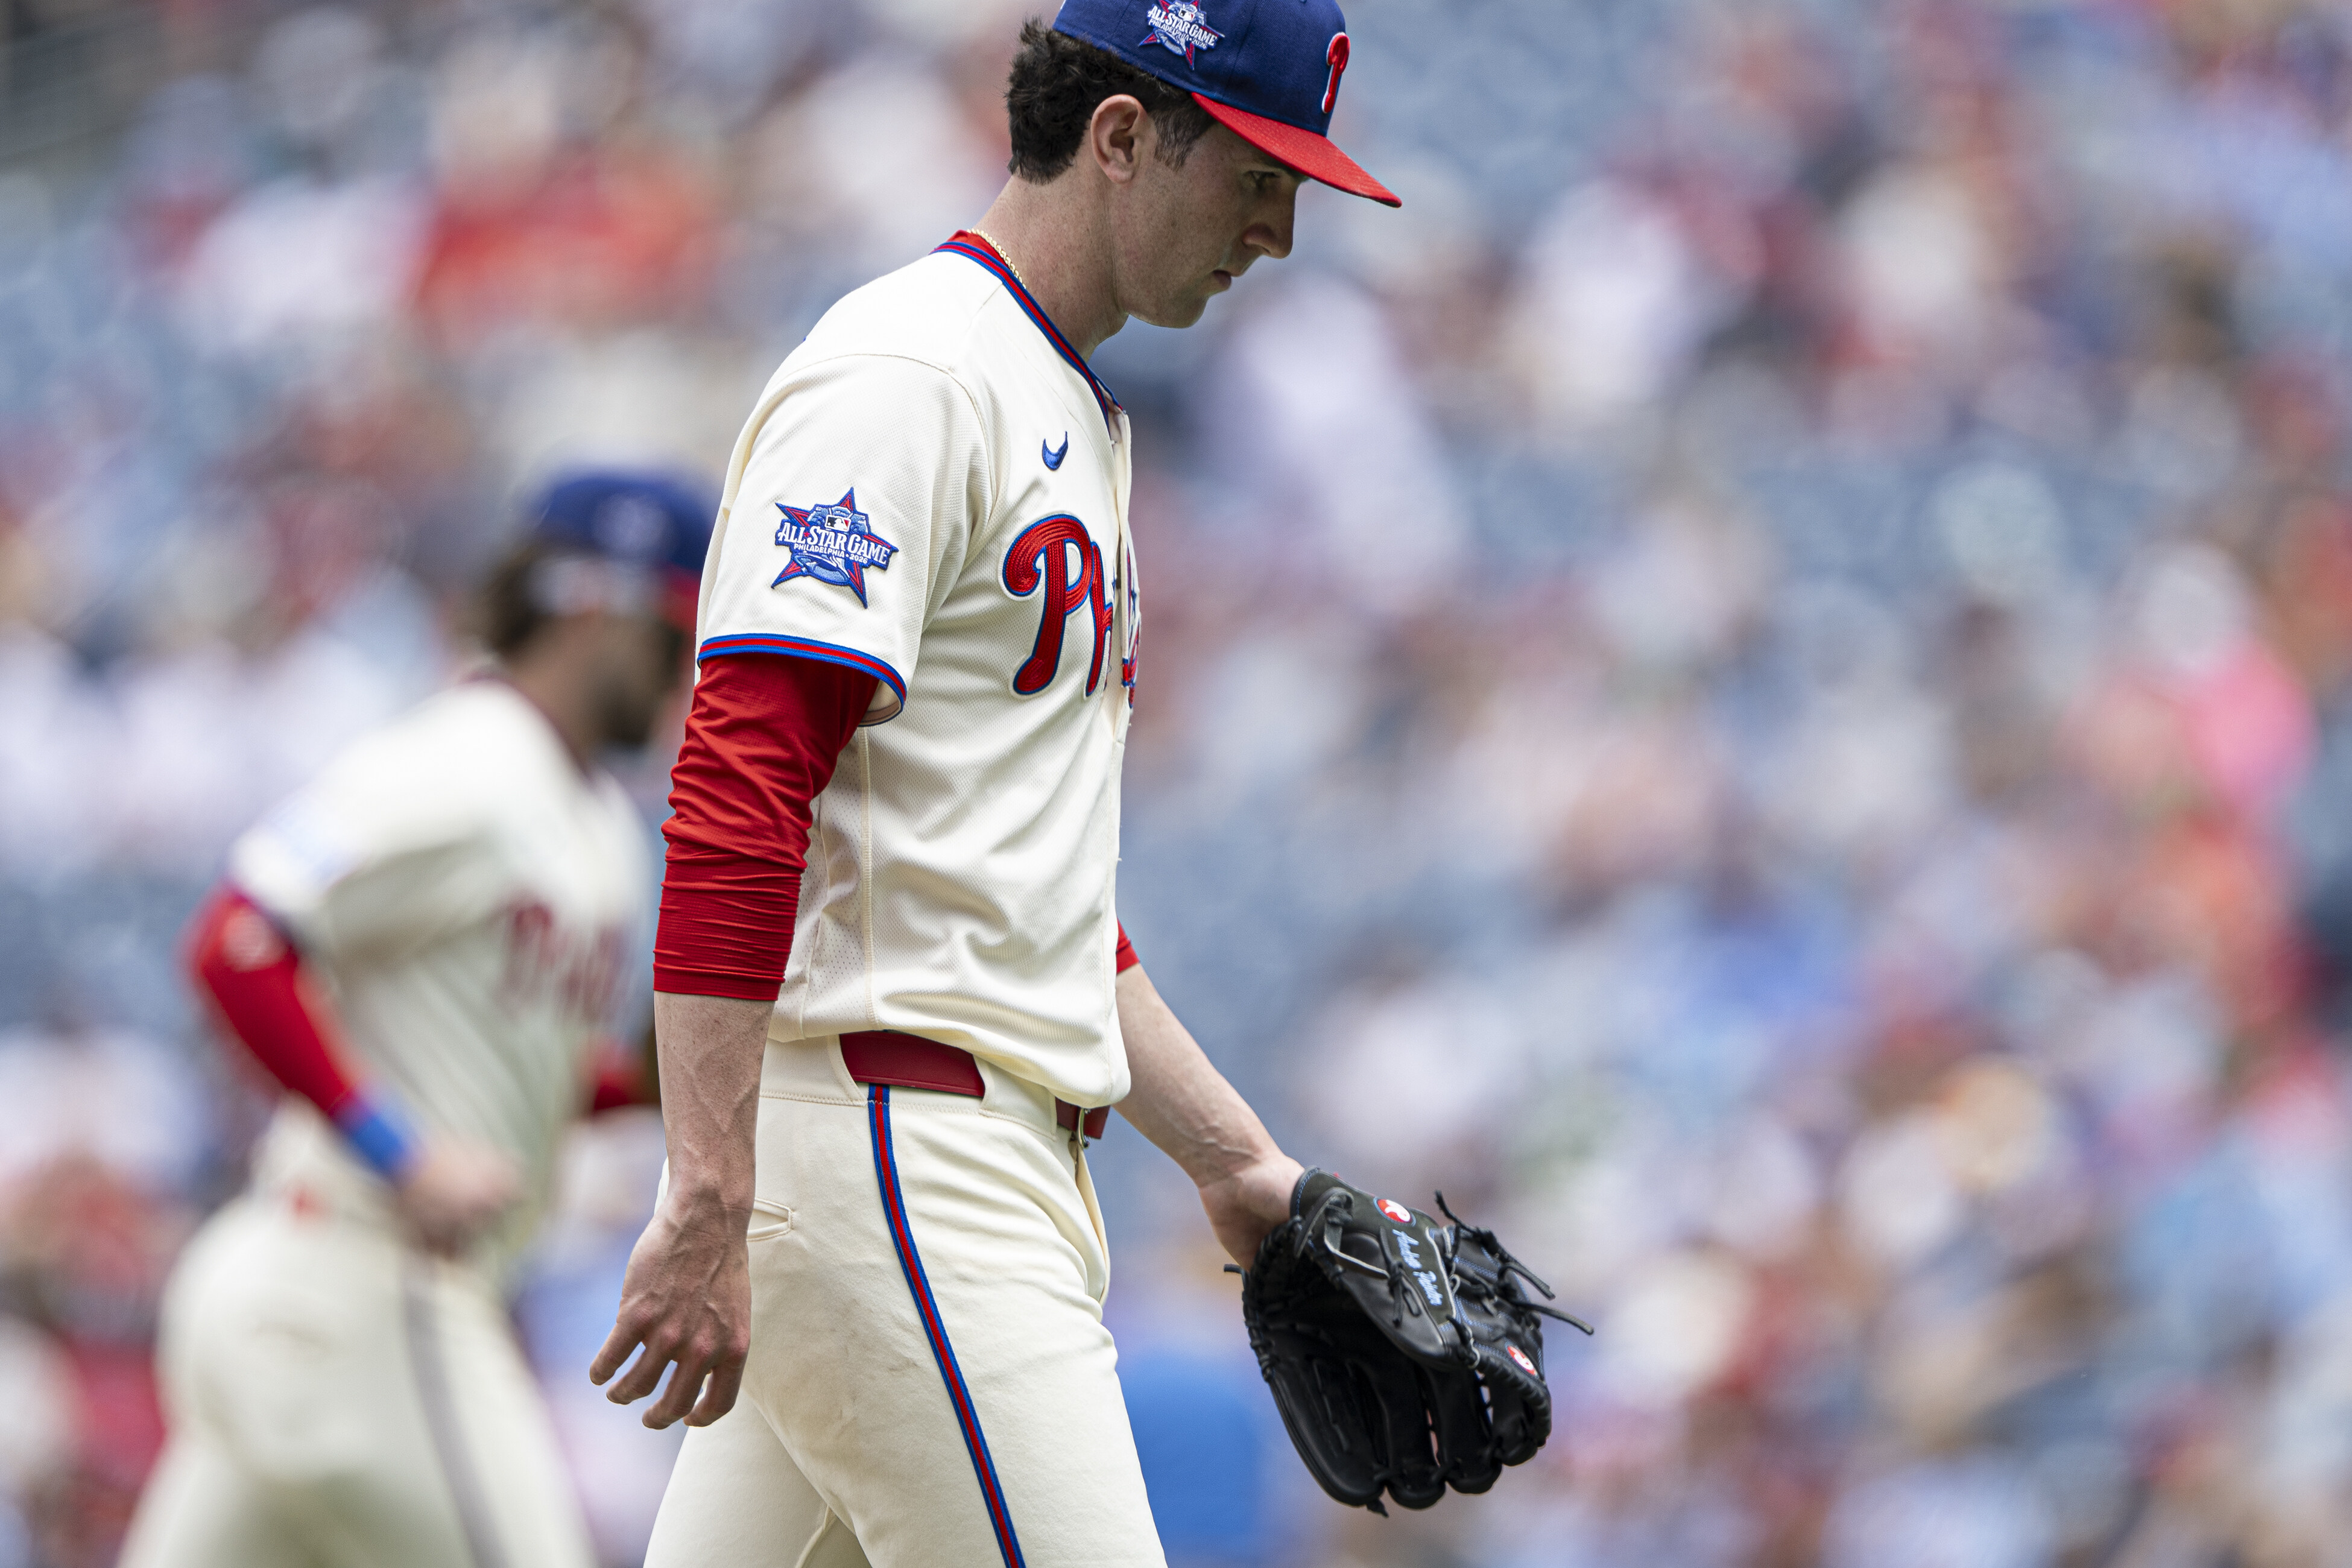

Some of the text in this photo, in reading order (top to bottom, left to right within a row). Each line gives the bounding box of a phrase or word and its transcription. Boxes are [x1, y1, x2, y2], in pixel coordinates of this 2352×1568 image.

[1148, 19, 1207, 48] PHILADELPHIA 2026
[1189, 24, 1218, 46] GAME
[794, 543, 868, 564] PHILADELPHIA 2026
[847, 534, 890, 564] GAME
